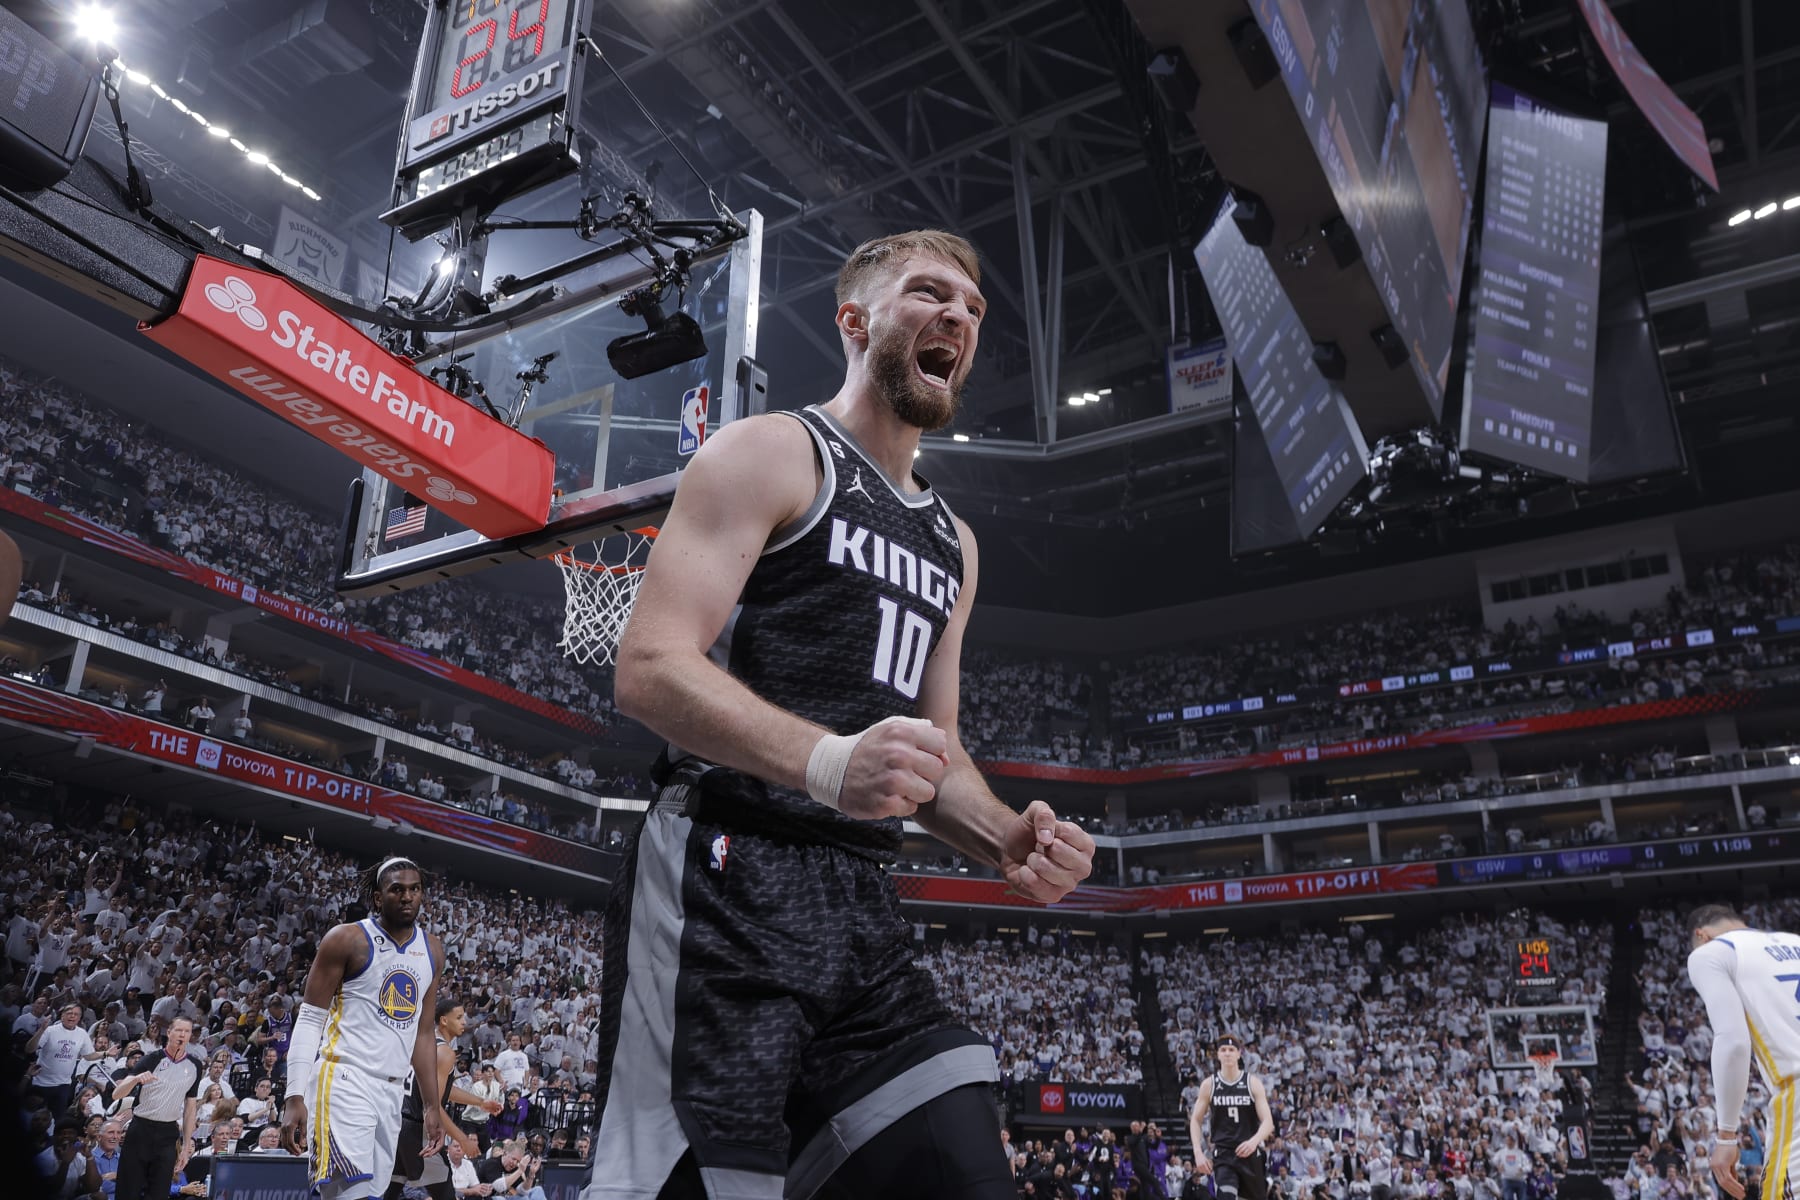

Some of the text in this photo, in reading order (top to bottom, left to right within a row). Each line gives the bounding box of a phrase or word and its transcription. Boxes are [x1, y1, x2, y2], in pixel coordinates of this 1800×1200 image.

[451, 0, 549, 98] 24
[1272, 15, 1296, 72] GSW
[449, 61, 560, 128] TISSOT
[1535, 105, 1583, 141] KINGS
[288, 221, 338, 257] RICHMOND
[1176, 361, 1215, 378] SLEEP
[1186, 367, 1225, 384] TRAIN
[682, 437, 695, 452] NBA
[829, 440, 845, 459] 6
[827, 515, 960, 620] KINGS
[214, 575, 350, 635] THE TOYOTA TIP-OFF!
[872, 595, 933, 700] 10
[1574, 648, 1596, 661] NYK
[1651, 637, 1672, 649] CLE
[1732, 624, 1759, 637] FINAL
[1352, 682, 1369, 693] ATL
[1419, 672, 1440, 683] BOS
[1488, 662, 1512, 672] FINAL
[1157, 712, 1174, 722] BKN
[1215, 704, 1231, 713] PHI
[1282, 750, 1302, 761] THE
[1352, 735, 1407, 753] TIP-OFF!
[149, 730, 372, 804] THE TOYOTA TIP-OFF!
[1476, 860, 1507, 874] GSW
[1581, 851, 1609, 865] SAC
[1188, 870, 1380, 903] THE TOYOTA TIP-OFF!
[382, 963, 421, 981] GOLDEN STATE
[1520, 953, 1550, 976] 24
[405, 984, 412, 998] 5
[1527, 977, 1557, 986] TISSOT
[1069, 1092, 1126, 1108] TOYOTA
[1213, 1095, 1251, 1106] KINGS
[1227, 1106, 1240, 1123] 9
